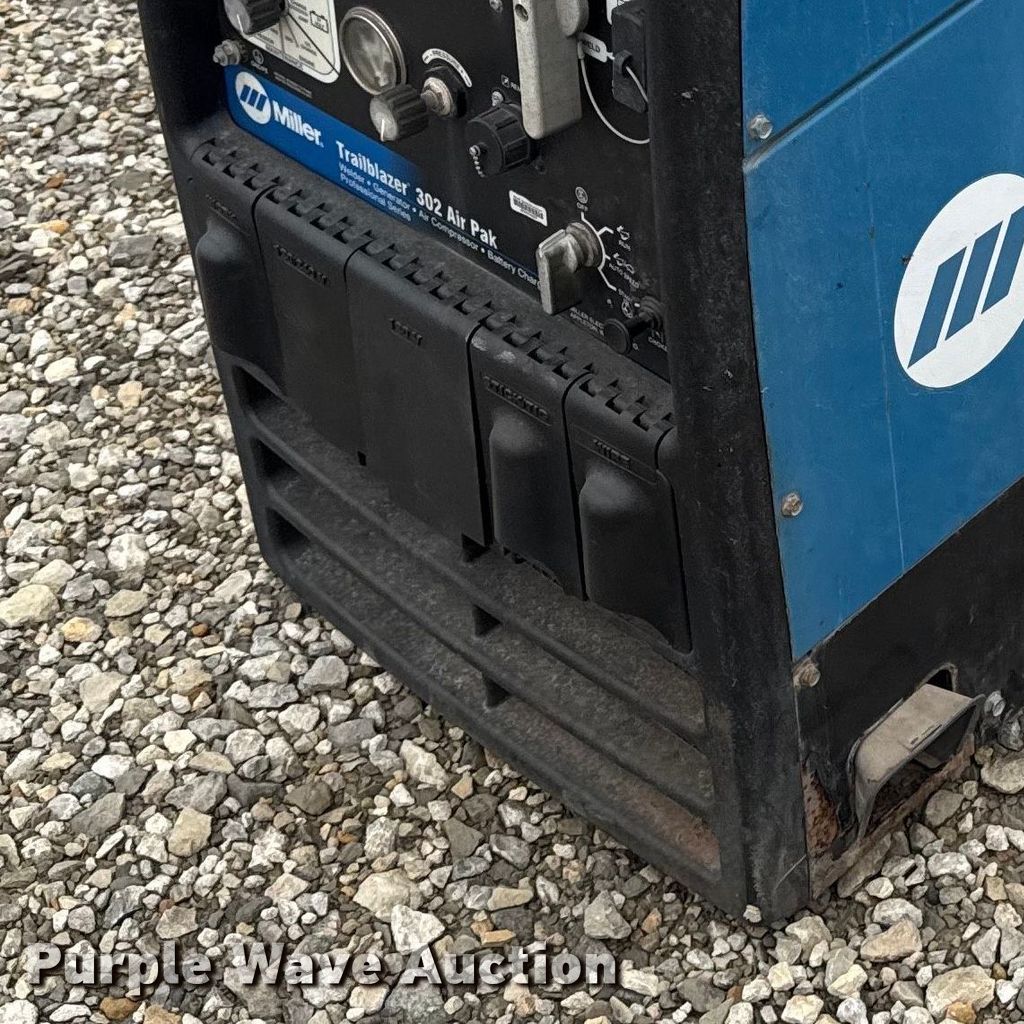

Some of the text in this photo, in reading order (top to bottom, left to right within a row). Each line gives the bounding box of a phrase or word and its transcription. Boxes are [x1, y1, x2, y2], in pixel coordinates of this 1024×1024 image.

[272, 100, 322, 147] Miller
[335, 140, 499, 249] Trailblazer 302 Air Pak
[338, 162, 540, 289] Welder Generator Air Compressor Battery Char
[340, 172, 412, 222] Professional Series
